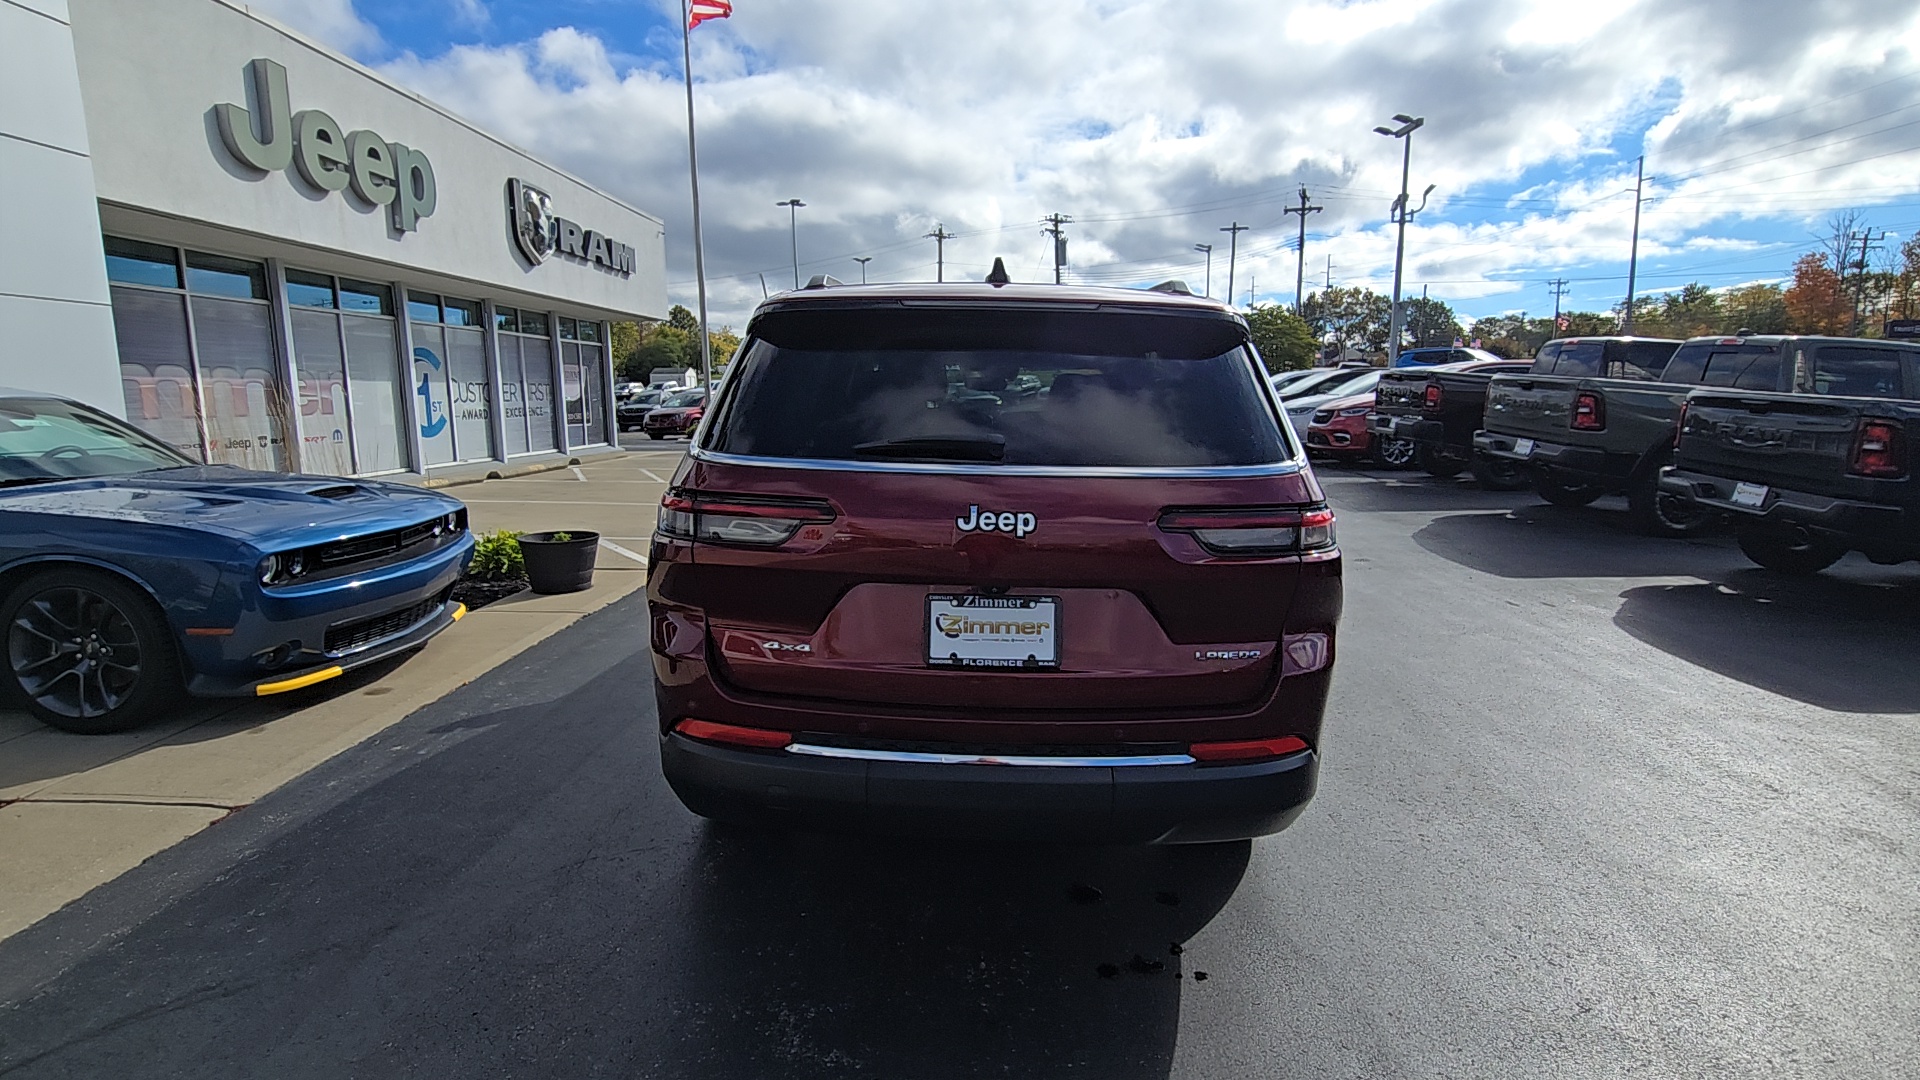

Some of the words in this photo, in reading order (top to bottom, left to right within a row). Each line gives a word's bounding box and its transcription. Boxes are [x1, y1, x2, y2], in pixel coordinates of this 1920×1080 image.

[214, 58, 437, 233] Jeep
[557, 217, 636, 275] RAM
[451, 377, 518, 404] CUSTOER
[461, 408, 489, 420] AWARD
[225, 436, 251, 450] Jeep
[303, 435, 328, 444] SRT
[956, 505, 1036, 537] Jeep
[963, 595, 1024, 608] Zimmer
[942, 614, 1050, 635] Zimmer
[762, 641, 811, 652] 4x4
[962, 659, 1024, 667] FLORENCE
